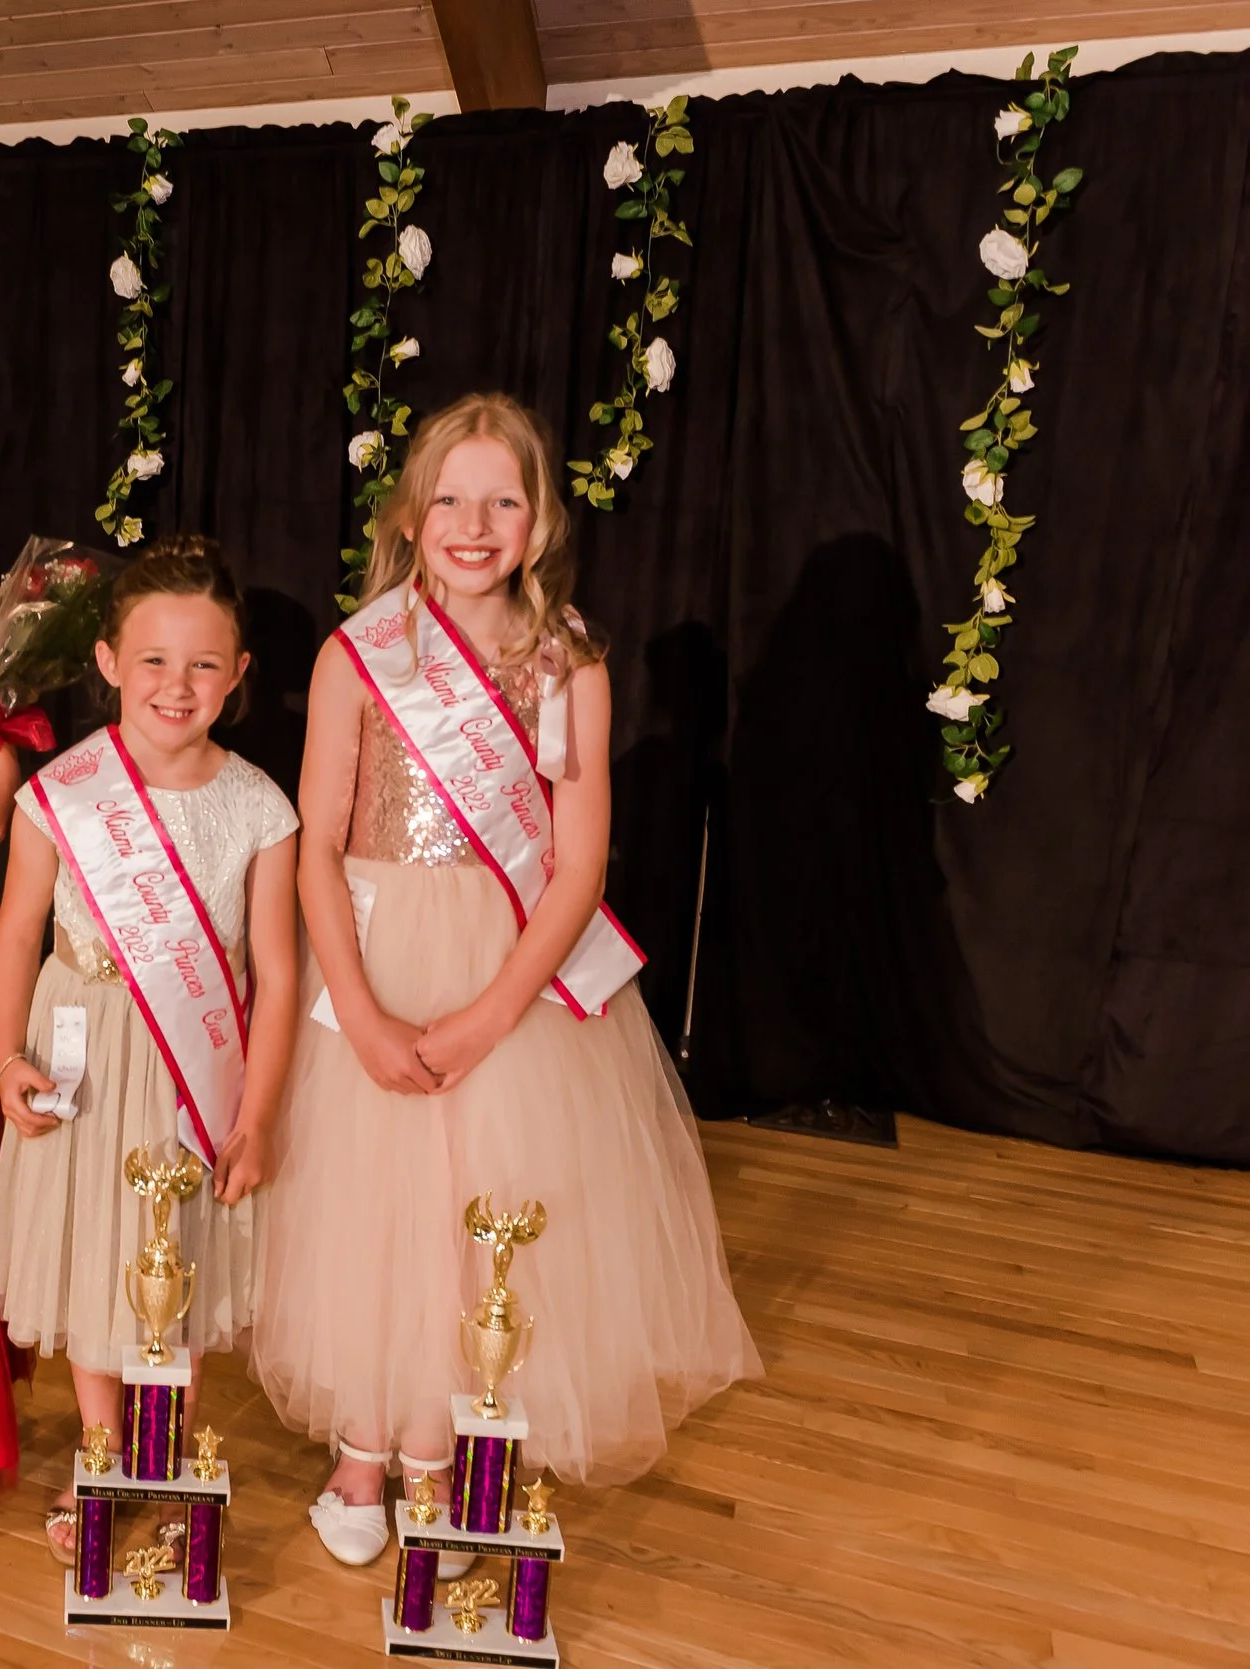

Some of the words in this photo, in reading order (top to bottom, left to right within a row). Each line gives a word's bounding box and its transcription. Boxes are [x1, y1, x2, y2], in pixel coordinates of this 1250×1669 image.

[419, 655, 467, 708] Miami
[460, 717, 508, 772] County
[500, 781, 540, 840] Princess
[450, 775, 491, 813] 2022
[96, 800, 143, 859] Miami
[133, 871, 170, 925] County
[165, 939, 205, 998] Princess
[118, 927, 154, 964] 2022
[91, 1488, 115, 1498] MIAMI
[116, 1489, 144, 1499] COUNTY
[147, 1491, 180, 1501] PRINCESS
[123, 1545, 176, 1577] 2022
[445, 1578, 501, 1608] 2022
